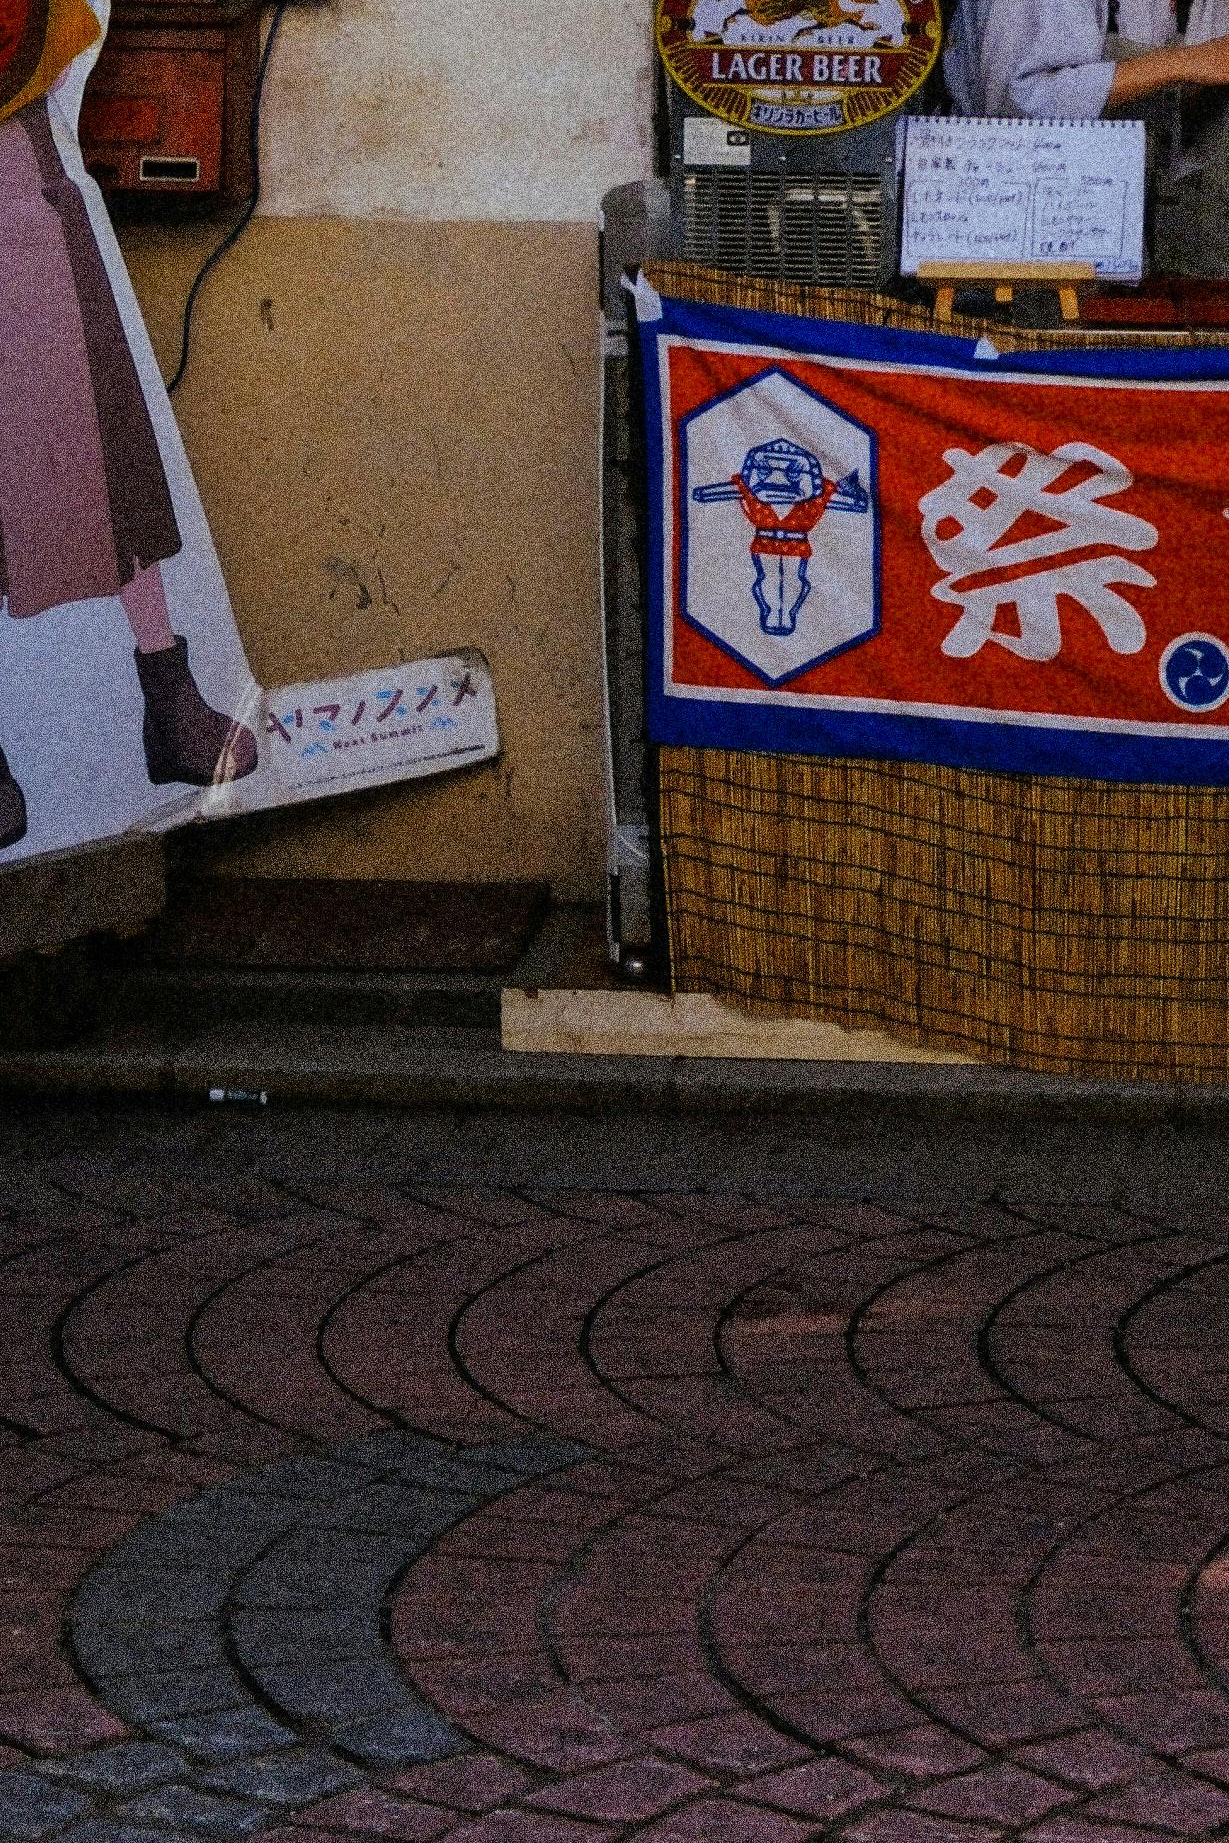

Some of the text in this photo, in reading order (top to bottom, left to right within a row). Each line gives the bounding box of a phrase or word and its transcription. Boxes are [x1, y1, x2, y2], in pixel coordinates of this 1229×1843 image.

[711, 52, 883, 84] LAGER BEER
[370, 724, 425, 744] Summit
